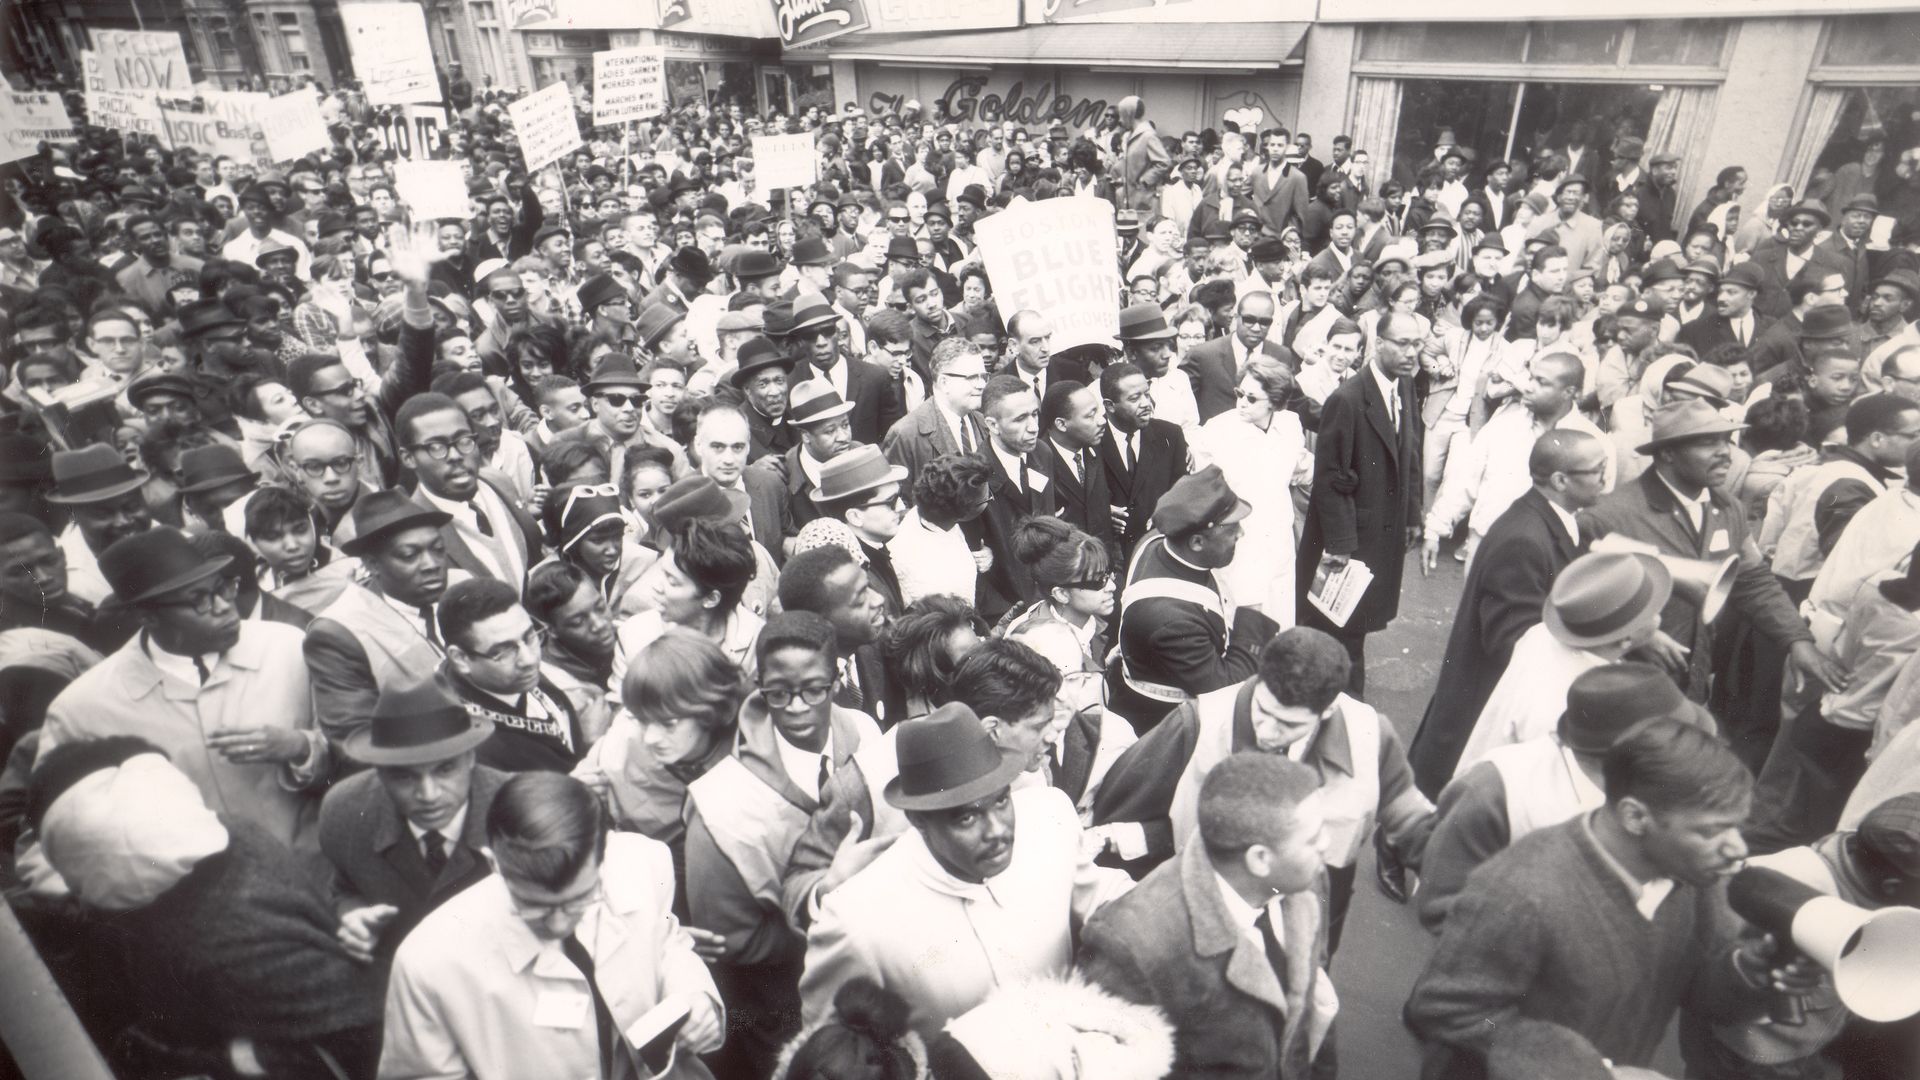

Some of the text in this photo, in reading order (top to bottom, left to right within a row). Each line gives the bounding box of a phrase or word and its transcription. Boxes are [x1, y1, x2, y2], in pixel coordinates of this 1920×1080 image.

[603, 55, 658, 67] INTERNATIONAL
[113, 56, 173, 90] NOW
[599, 65, 660, 80] LADIES GARMENT
[601, 77, 657, 90] WORKERS UNION
[98, 95, 137, 116] RACIAL
[596, 100, 658, 118] MARTIN LUTHER KING
[605, 92, 653, 105] MARCHES WITH
[941, 76, 1107, 129] Golden
[1001, 212, 1098, 246] BOSTON
[1010, 238, 1105, 282] BLUE
[1010, 272, 1117, 313] FLIGHT
